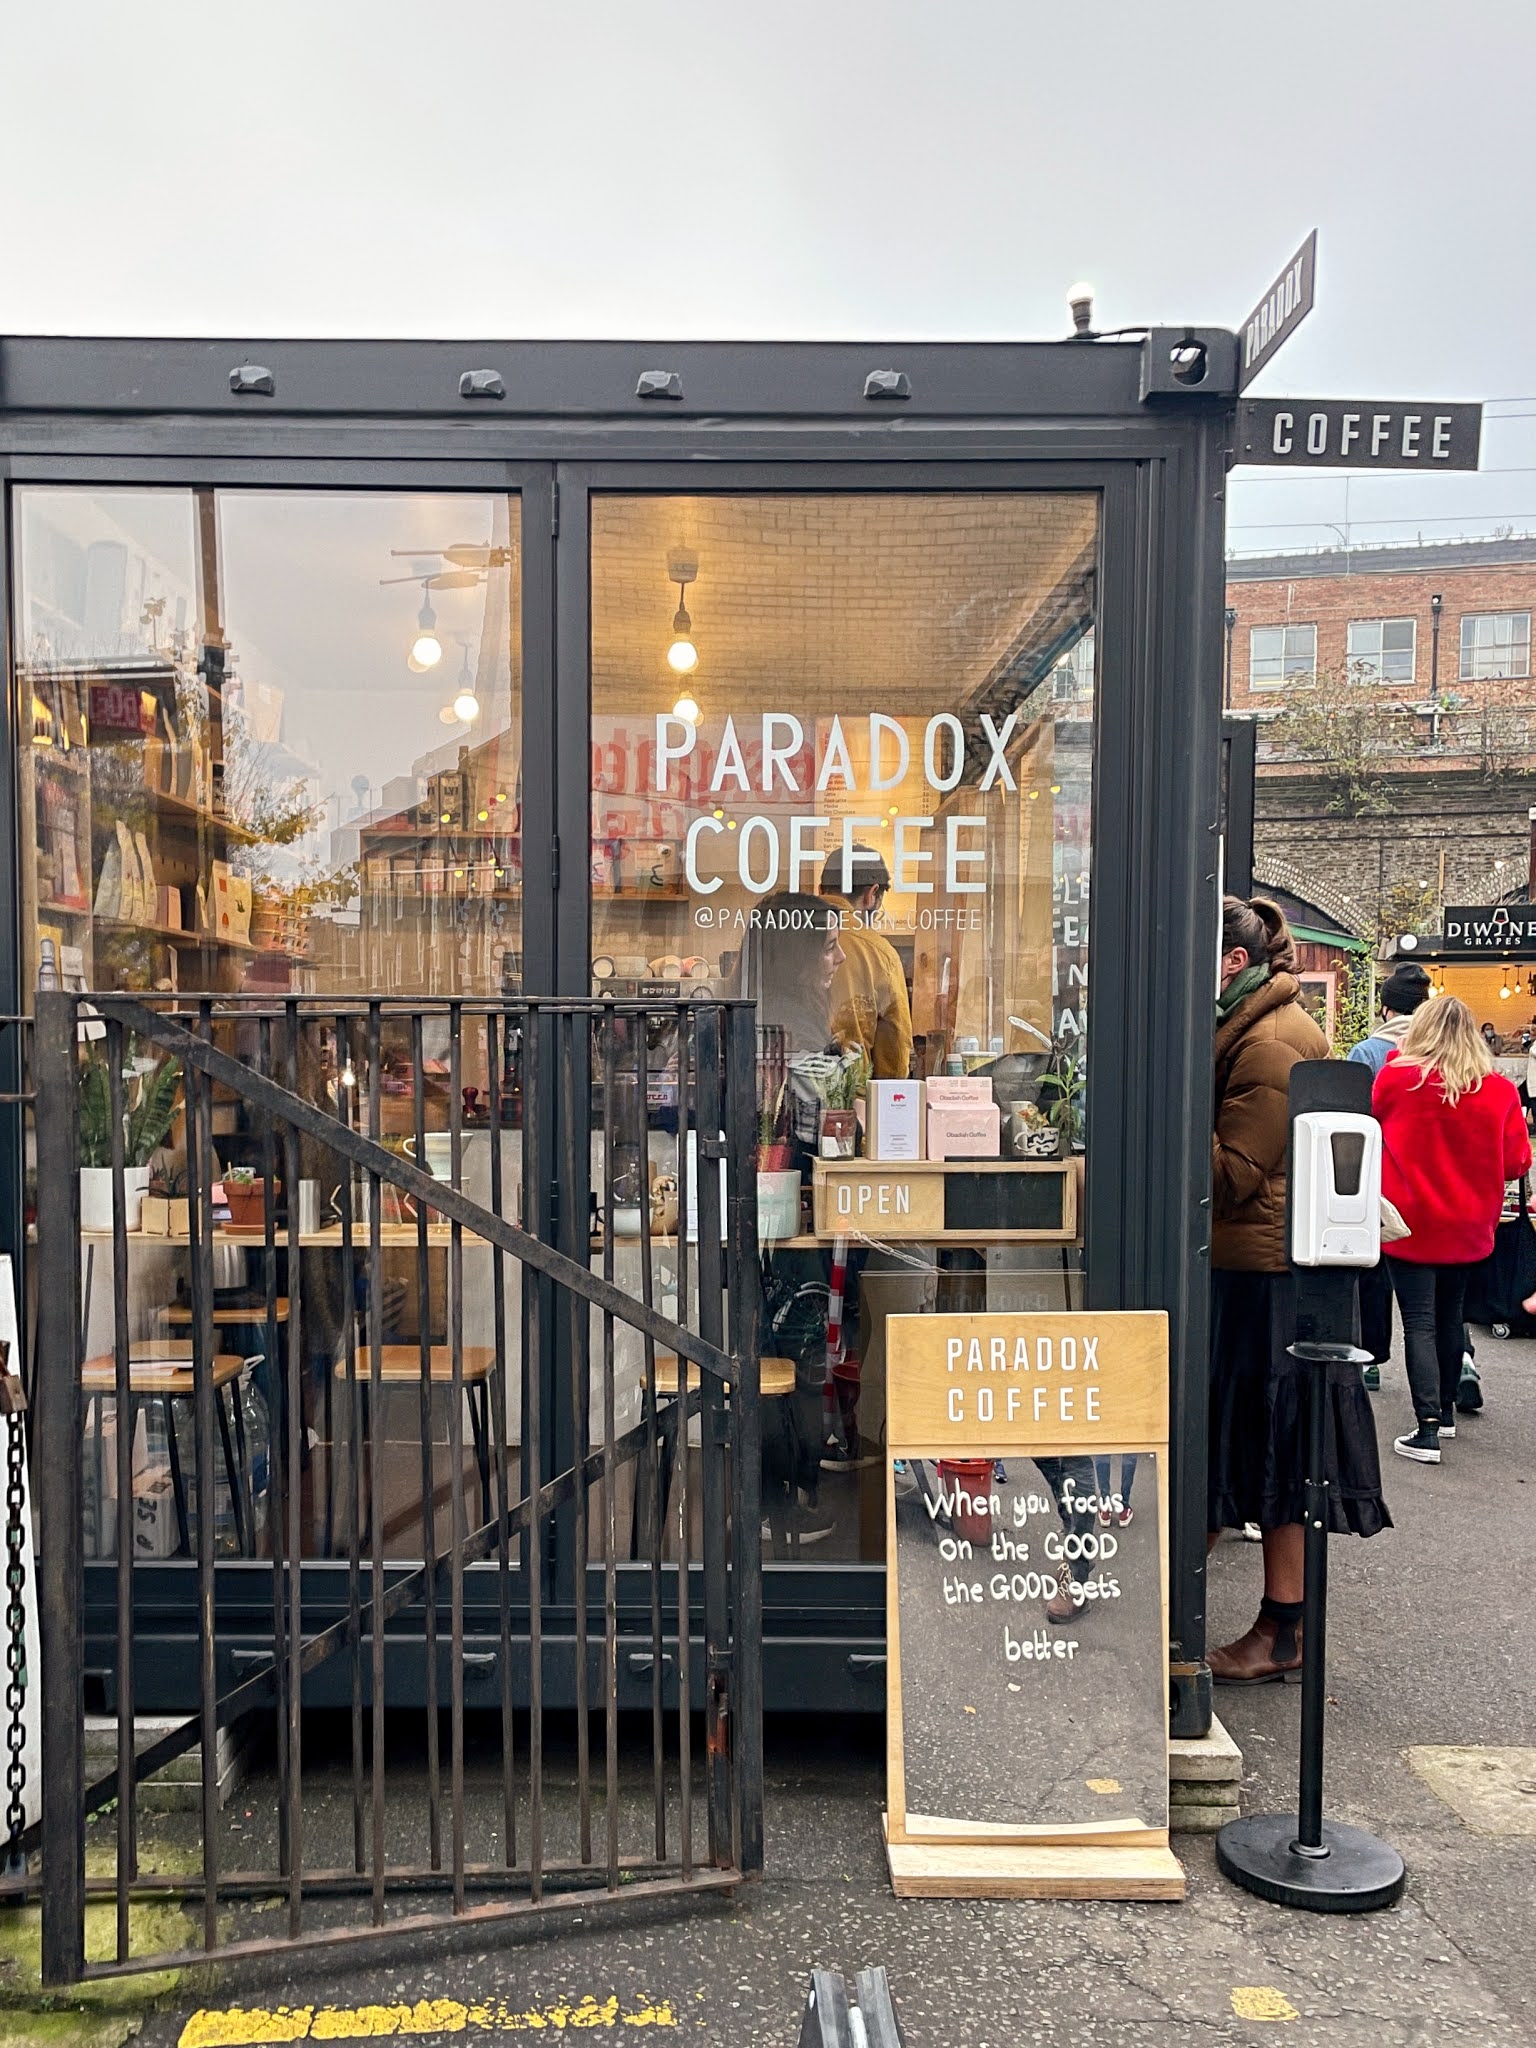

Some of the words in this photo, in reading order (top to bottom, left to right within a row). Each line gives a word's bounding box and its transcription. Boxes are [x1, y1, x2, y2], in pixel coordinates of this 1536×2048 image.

[1245, 256, 1303, 369] PARADOX
[1273, 412, 1453, 458] COFFEE
[656, 712, 1018, 792] PARADOX
[685, 815, 987, 895] COFFEE
[1464, 937, 1521, 946] GRAPES
[837, 1184, 911, 1215] OPEN
[946, 1336, 1100, 1373] PARADOX
[947, 1387, 1101, 1423] COFFEE
[923, 1477, 1001, 1520] When
[1013, 1493, 1051, 1528] you
[1061, 1477, 1125, 1515] focus
[991, 1531, 1030, 1562] the
[1044, 1532, 1119, 1561] GOOD
[942, 1576, 984, 1605] the
[990, 1571, 1059, 1602] GOOD
[1069, 1574, 1122, 1607] gets
[1003, 1625, 1080, 1662] better
